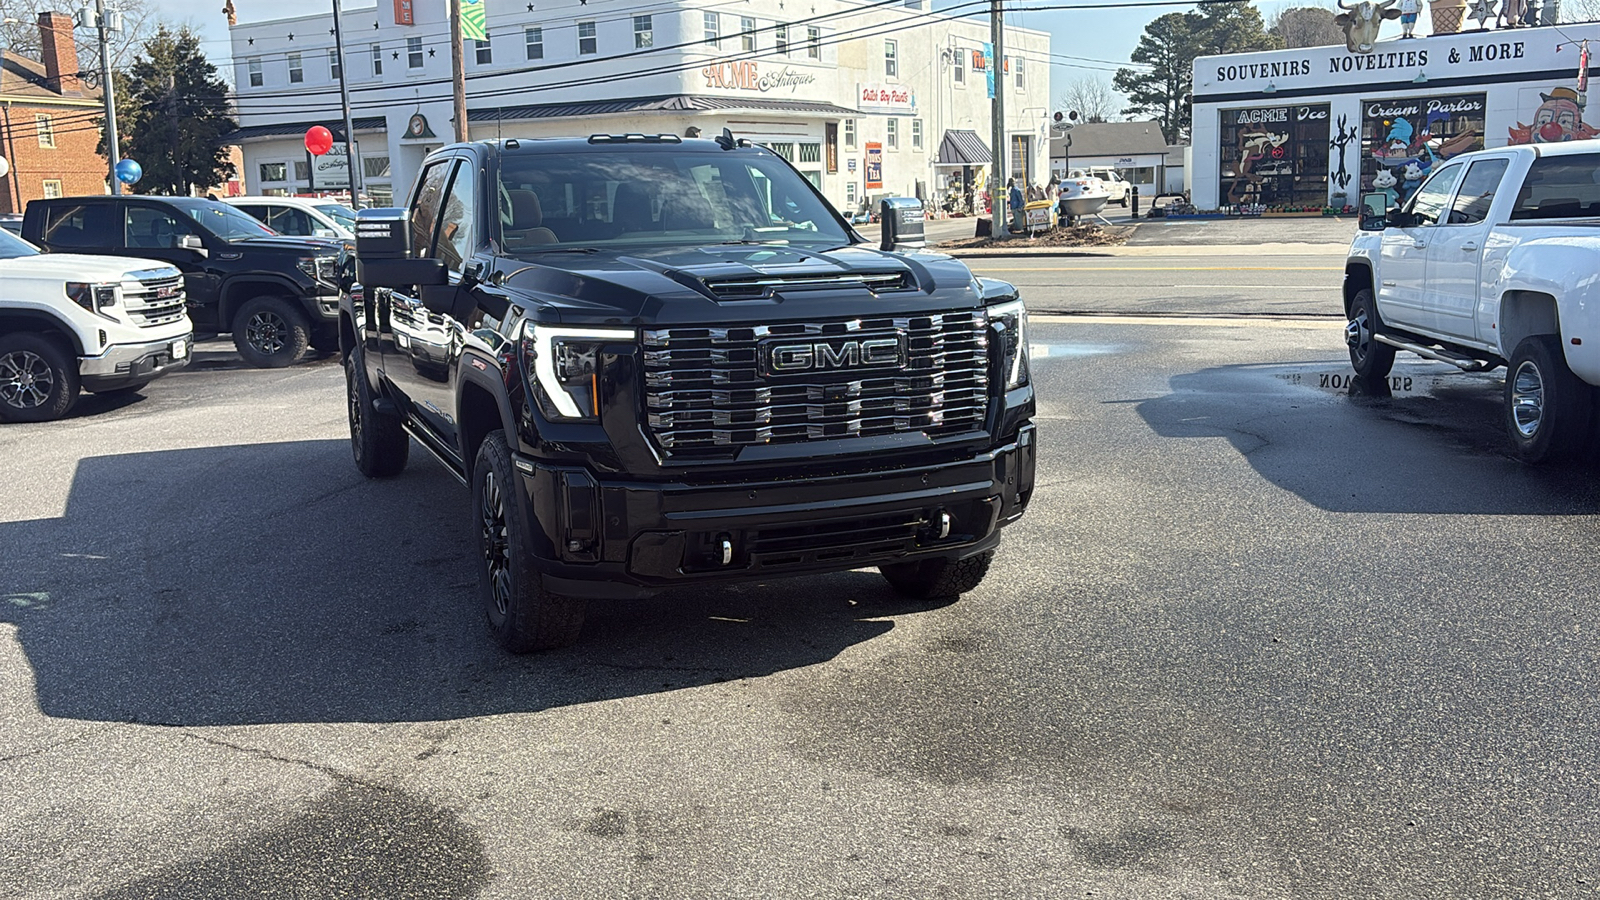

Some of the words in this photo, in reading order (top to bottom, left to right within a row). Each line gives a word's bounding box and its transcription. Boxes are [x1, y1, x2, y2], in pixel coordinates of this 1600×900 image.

[1217, 59, 1310, 82] SOUVENIRS
[1329, 49, 1428, 73] NOVELTIES
[1448, 47, 1460, 64] &
[1469, 42, 1524, 62] MORE
[702, 59, 759, 90] ACME
[862, 88, 878, 101] Dutch
[880, 89, 890, 105] Boy
[891, 90, 908, 103] Paints
[1237, 108, 1288, 124] ACME
[1297, 106, 1328, 121] Ice
[1367, 103, 1420, 118] Cream
[1426, 99, 1482, 114] Parlor
[868, 168, 881, 180] TEA
[772, 339, 898, 370] GMC
